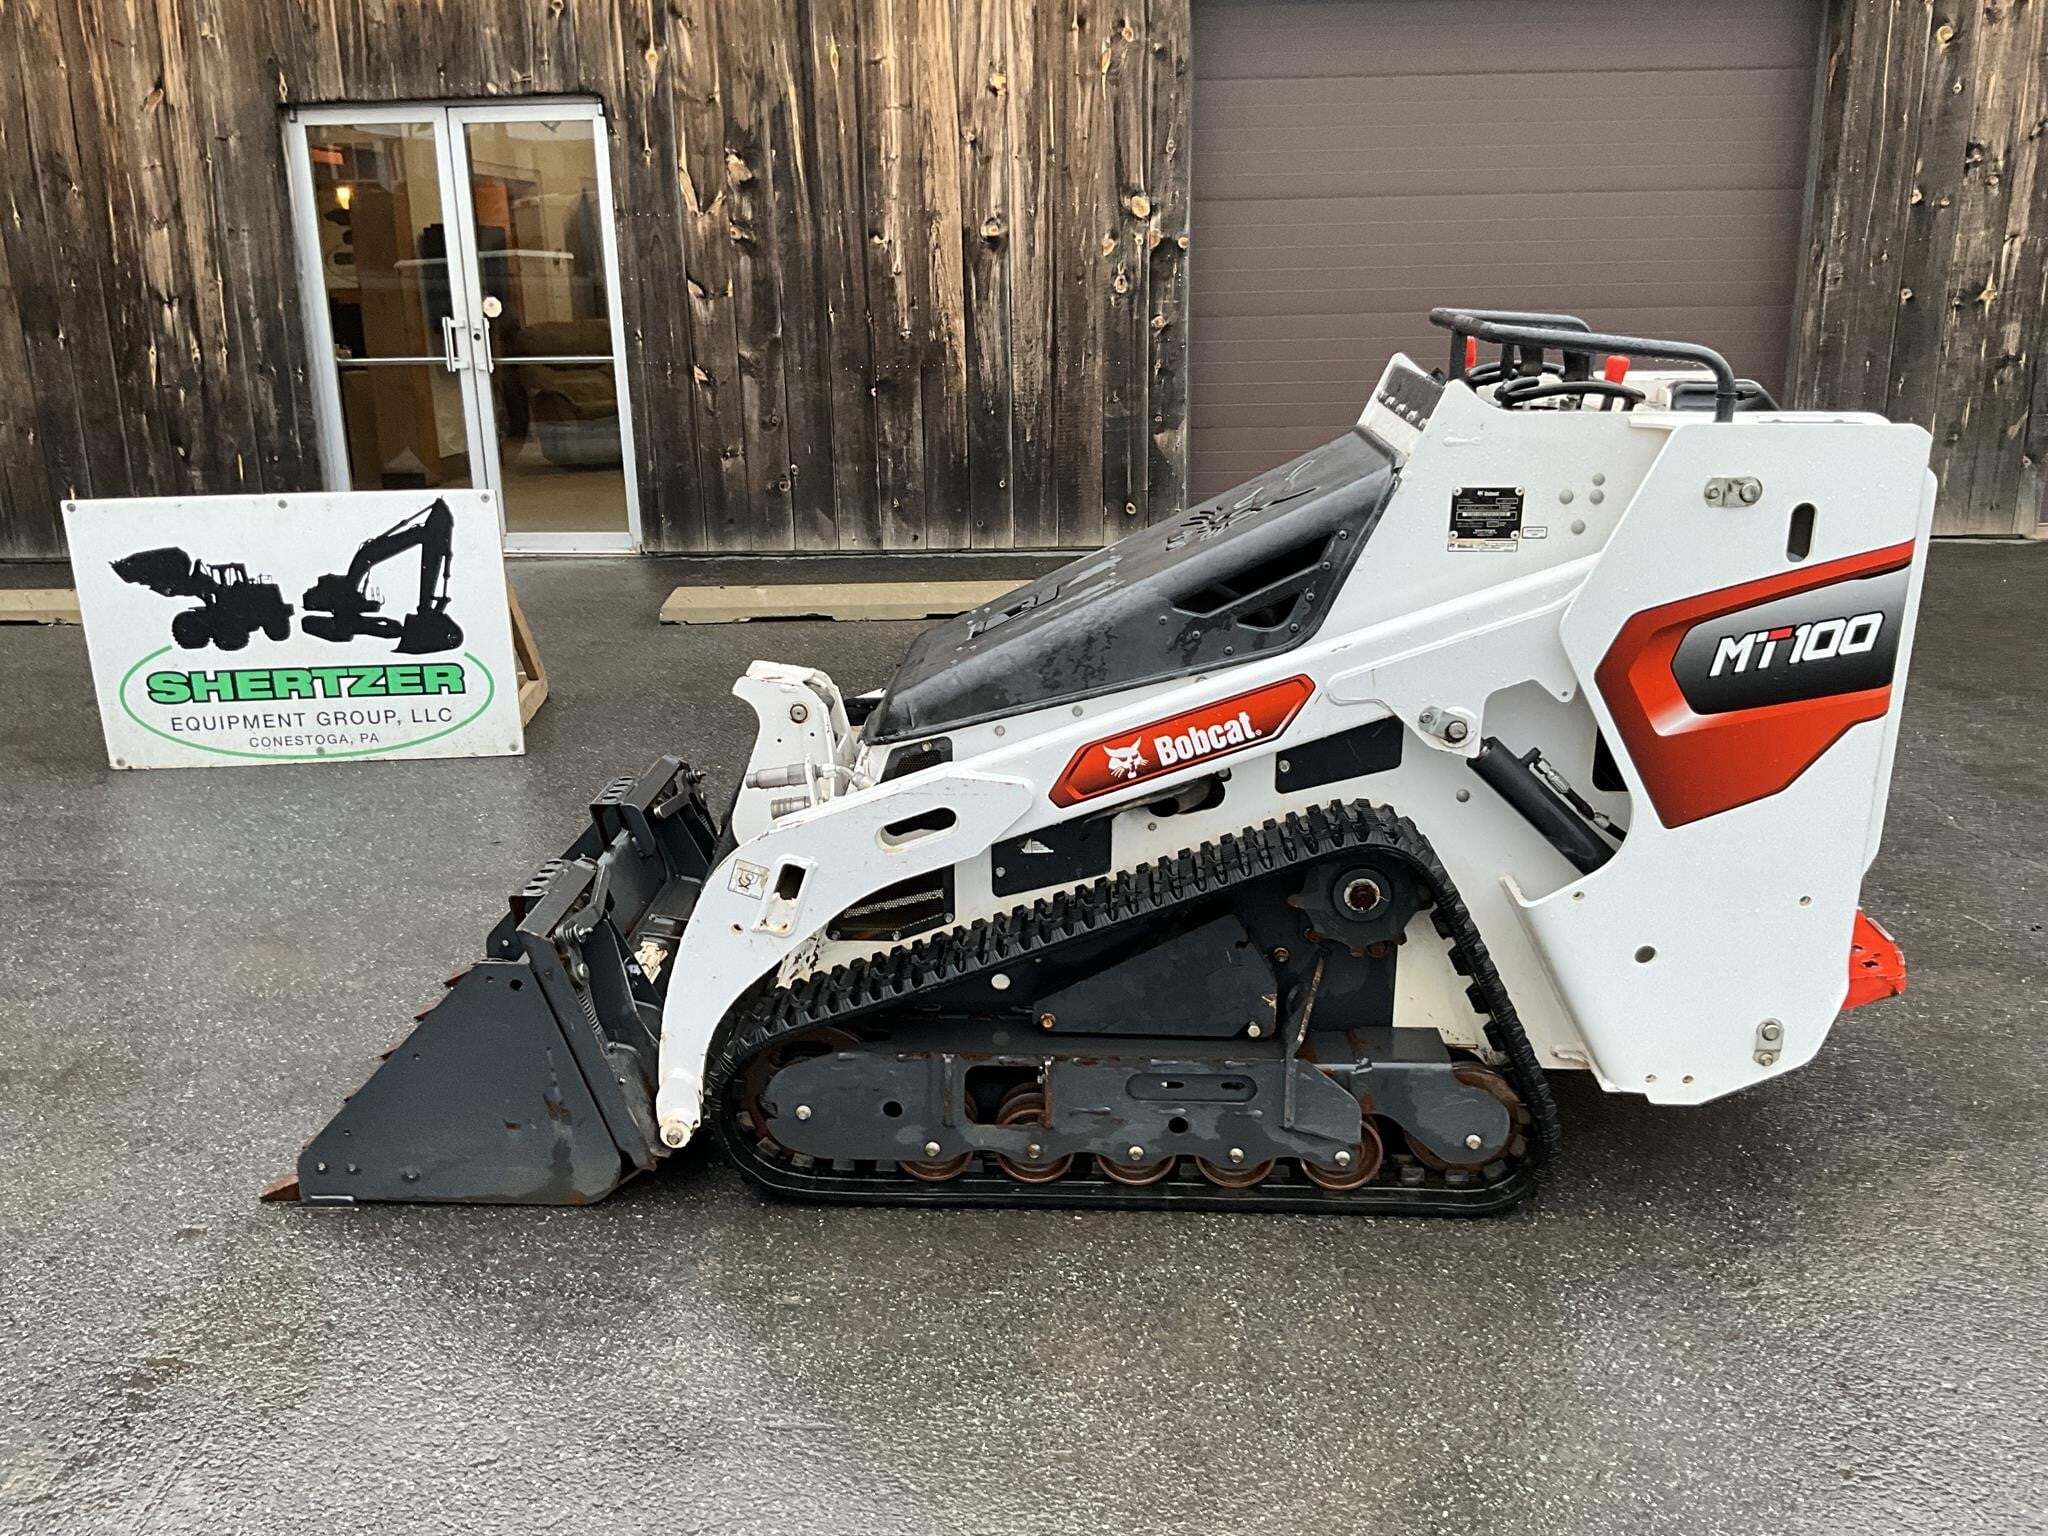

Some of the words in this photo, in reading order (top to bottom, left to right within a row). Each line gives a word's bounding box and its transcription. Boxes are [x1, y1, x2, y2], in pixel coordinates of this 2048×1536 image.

[1707, 611, 1885, 678] MT100
[146, 663, 465, 705] SHERTZER
[170, 711, 307, 732] EQUIPMENT
[316, 708, 402, 728] GROUP,
[410, 707, 454, 724] LLC
[249, 733, 354, 749] CONESTOGA,
[360, 732, 381, 745] PA
[1153, 711, 1257, 766] Bobcat
